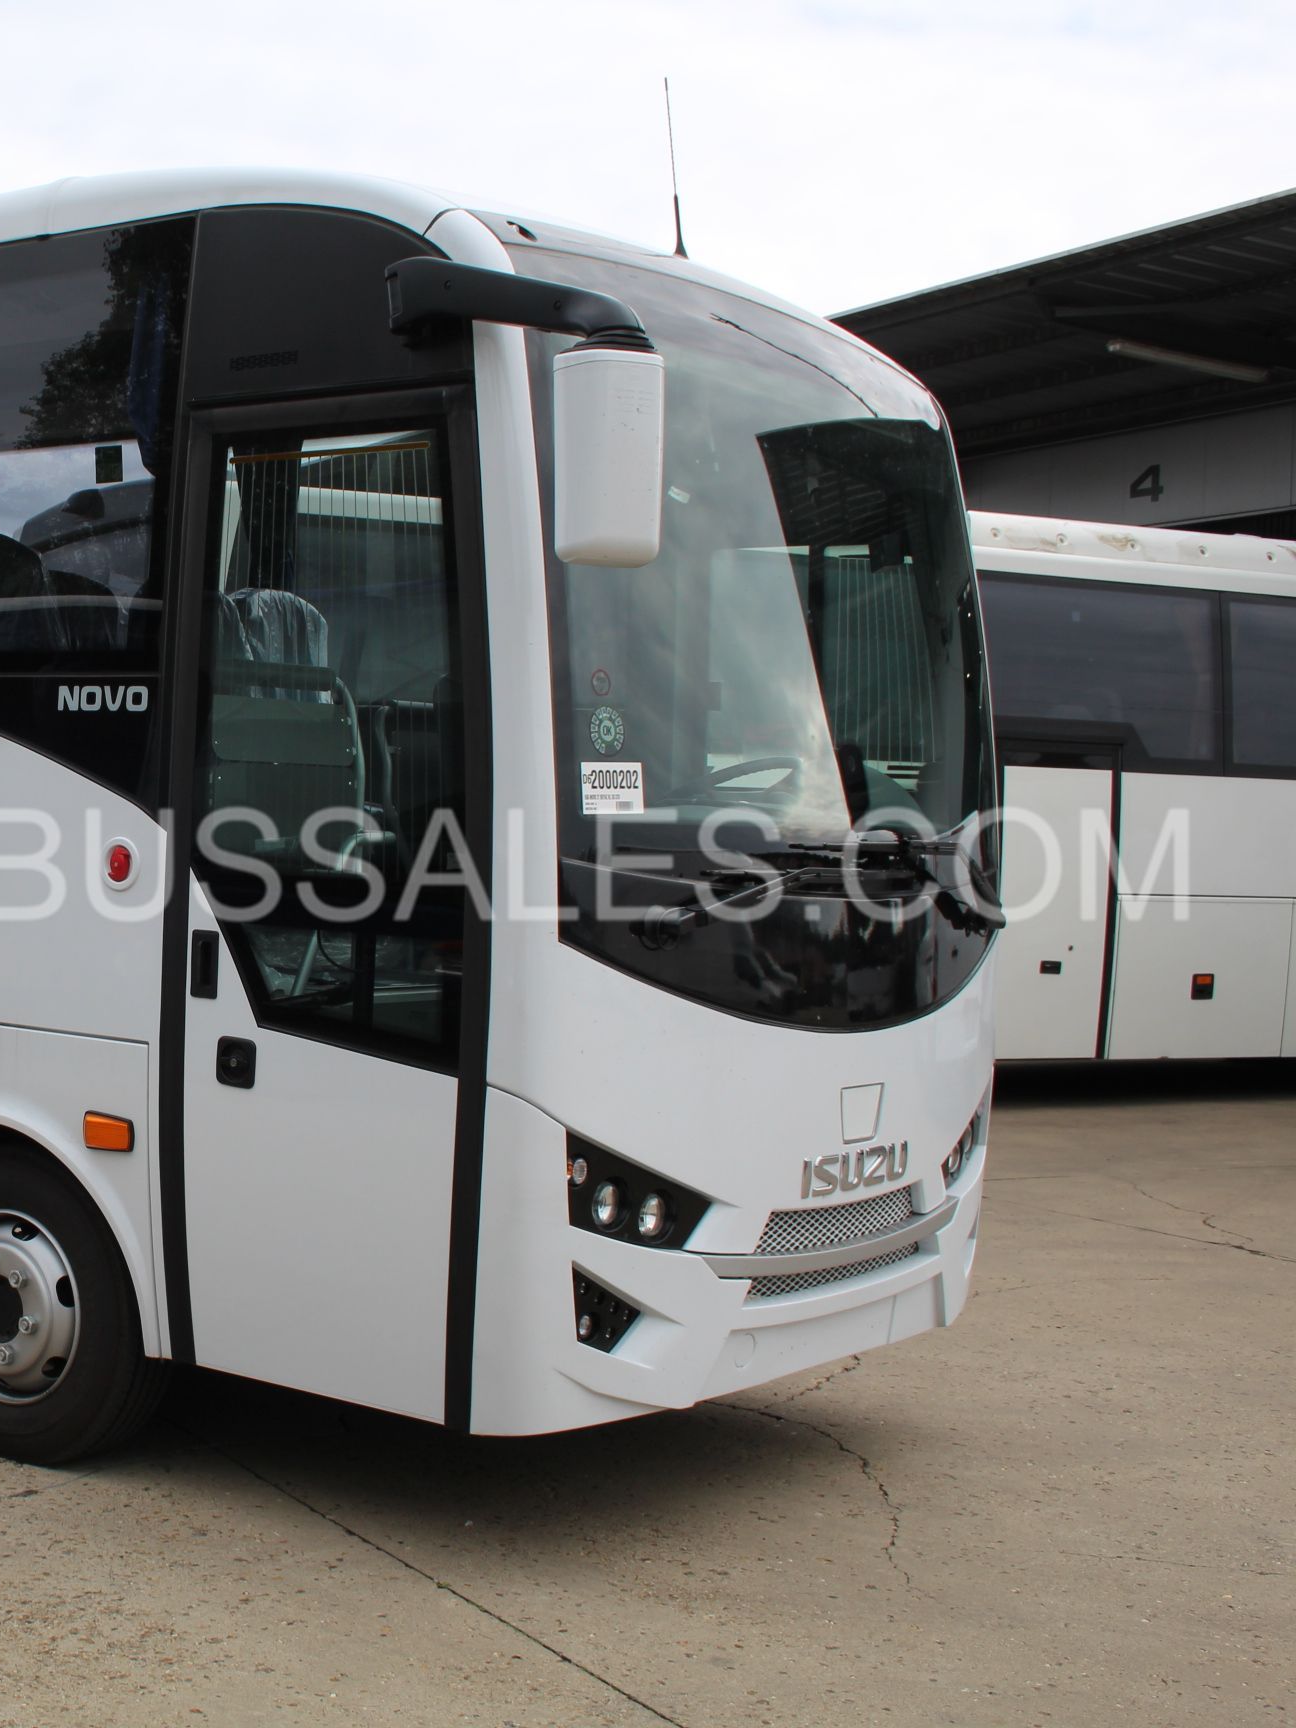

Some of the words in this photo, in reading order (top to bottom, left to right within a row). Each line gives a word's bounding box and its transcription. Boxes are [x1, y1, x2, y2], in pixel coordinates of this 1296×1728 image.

[1129, 464, 1164, 502] 4
[57, 685, 149, 712] NOVO
[603, 725, 613, 737] OK
[591, 769, 639, 790] 2000202
[800, 1139, 908, 1200] ISUZU
